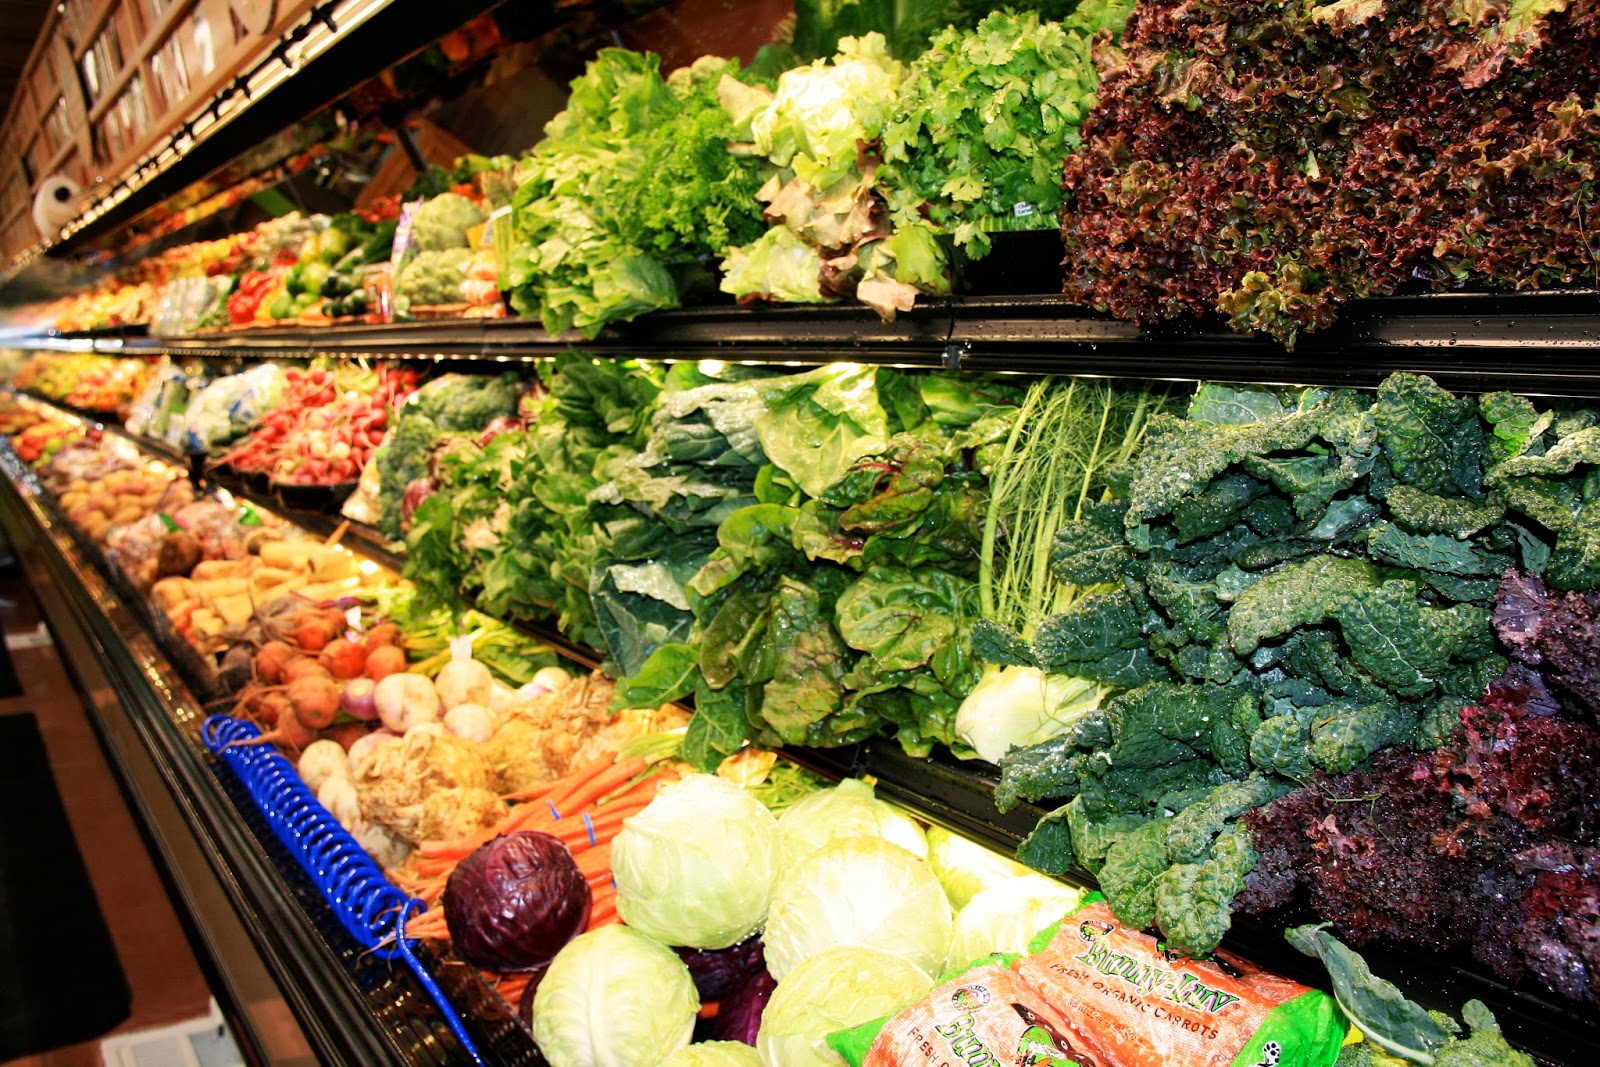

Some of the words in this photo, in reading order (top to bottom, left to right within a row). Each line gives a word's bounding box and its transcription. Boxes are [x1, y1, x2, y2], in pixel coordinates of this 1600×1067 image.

[1050, 963, 1090, 980] FRESH
[1093, 981, 1151, 1013] ORGANIC
[1154, 1007, 1219, 1040] CARROTS
[1074, 937, 1240, 1013] Bunny-Luv
[907, 1026, 939, 1063] FRESH
